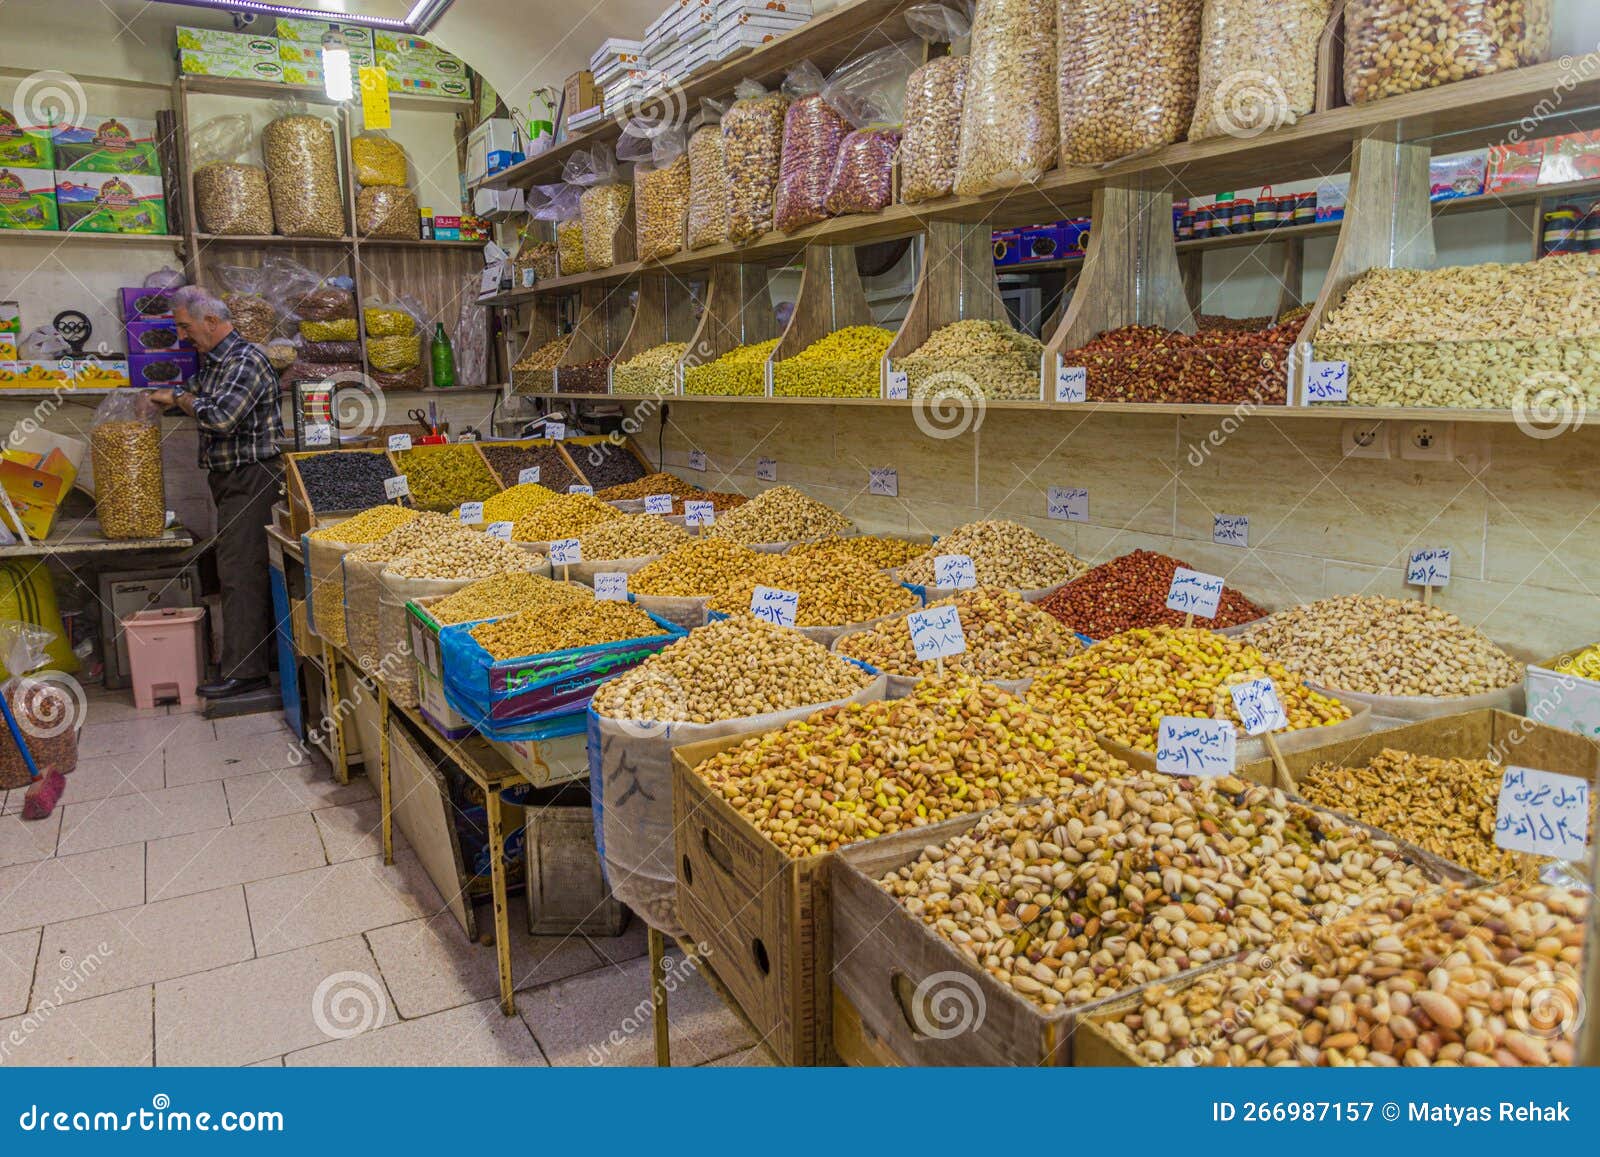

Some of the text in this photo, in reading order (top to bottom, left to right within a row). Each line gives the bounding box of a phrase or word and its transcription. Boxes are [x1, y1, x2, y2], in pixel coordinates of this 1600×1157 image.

[1200, 726, 1228, 746] آجیل
[1156, 747, 1185, 762] تومان
[1552, 785, 1587, 808] آجیل
[1495, 813, 1528, 836] تومان
